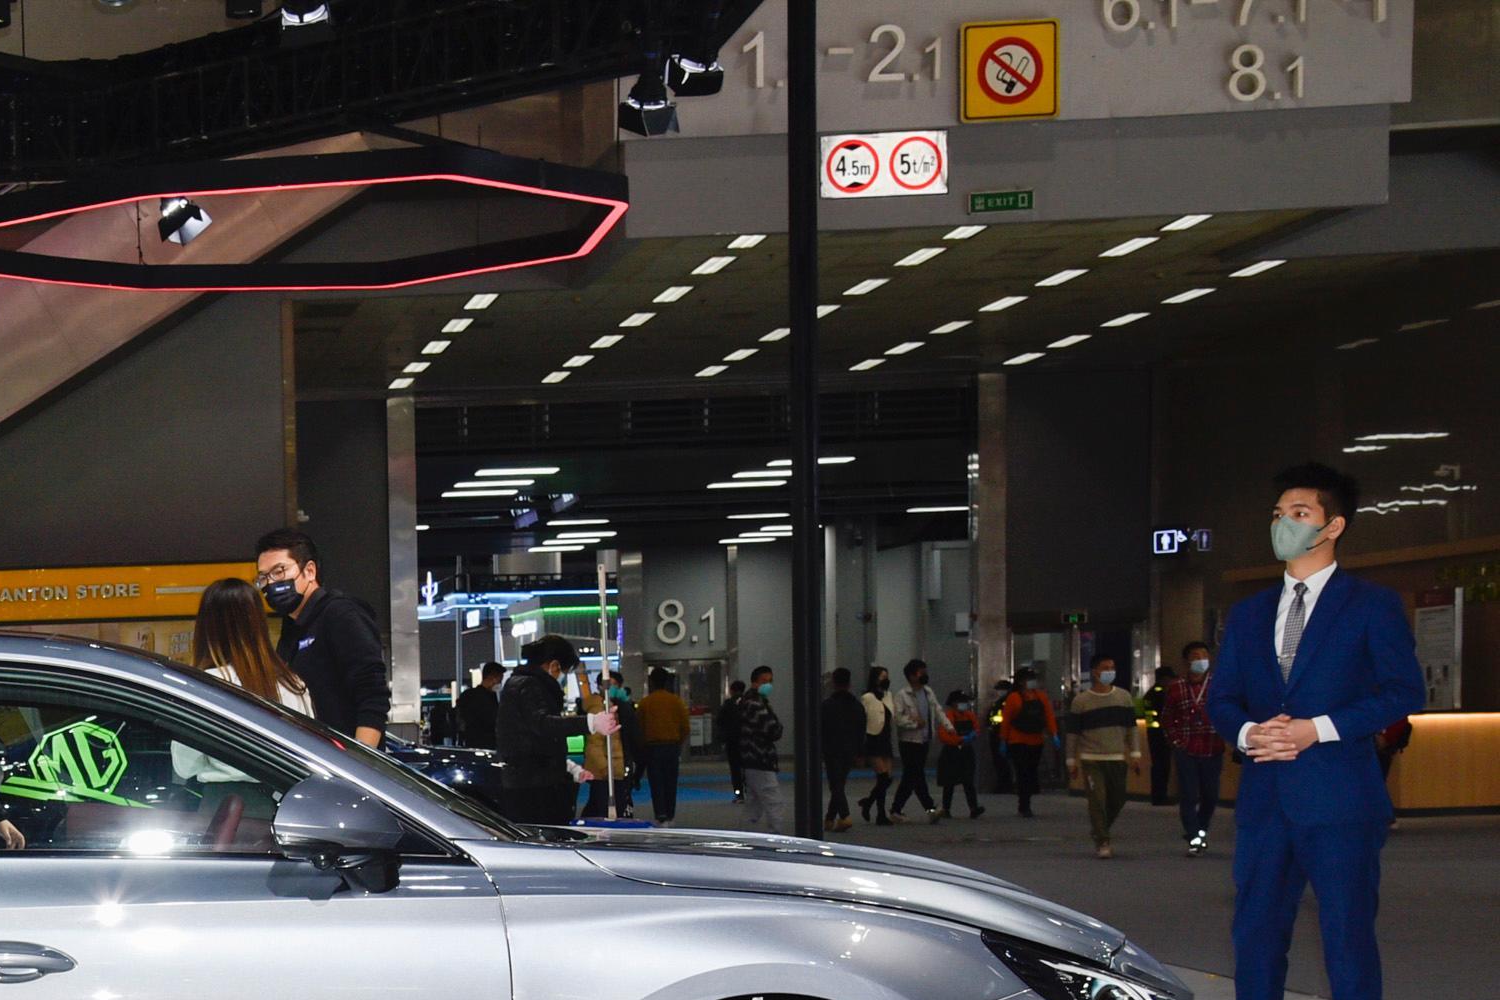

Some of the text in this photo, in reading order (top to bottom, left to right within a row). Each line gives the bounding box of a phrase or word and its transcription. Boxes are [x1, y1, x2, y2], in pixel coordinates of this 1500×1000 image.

[743, 24, 942, 89] 1.-2.1
[1228, 44, 1304, 101] 8.1
[835, 156, 871, 177] 4.5m
[76, 583, 140, 599] STORE
[656, 599, 716, 646] 8.1
